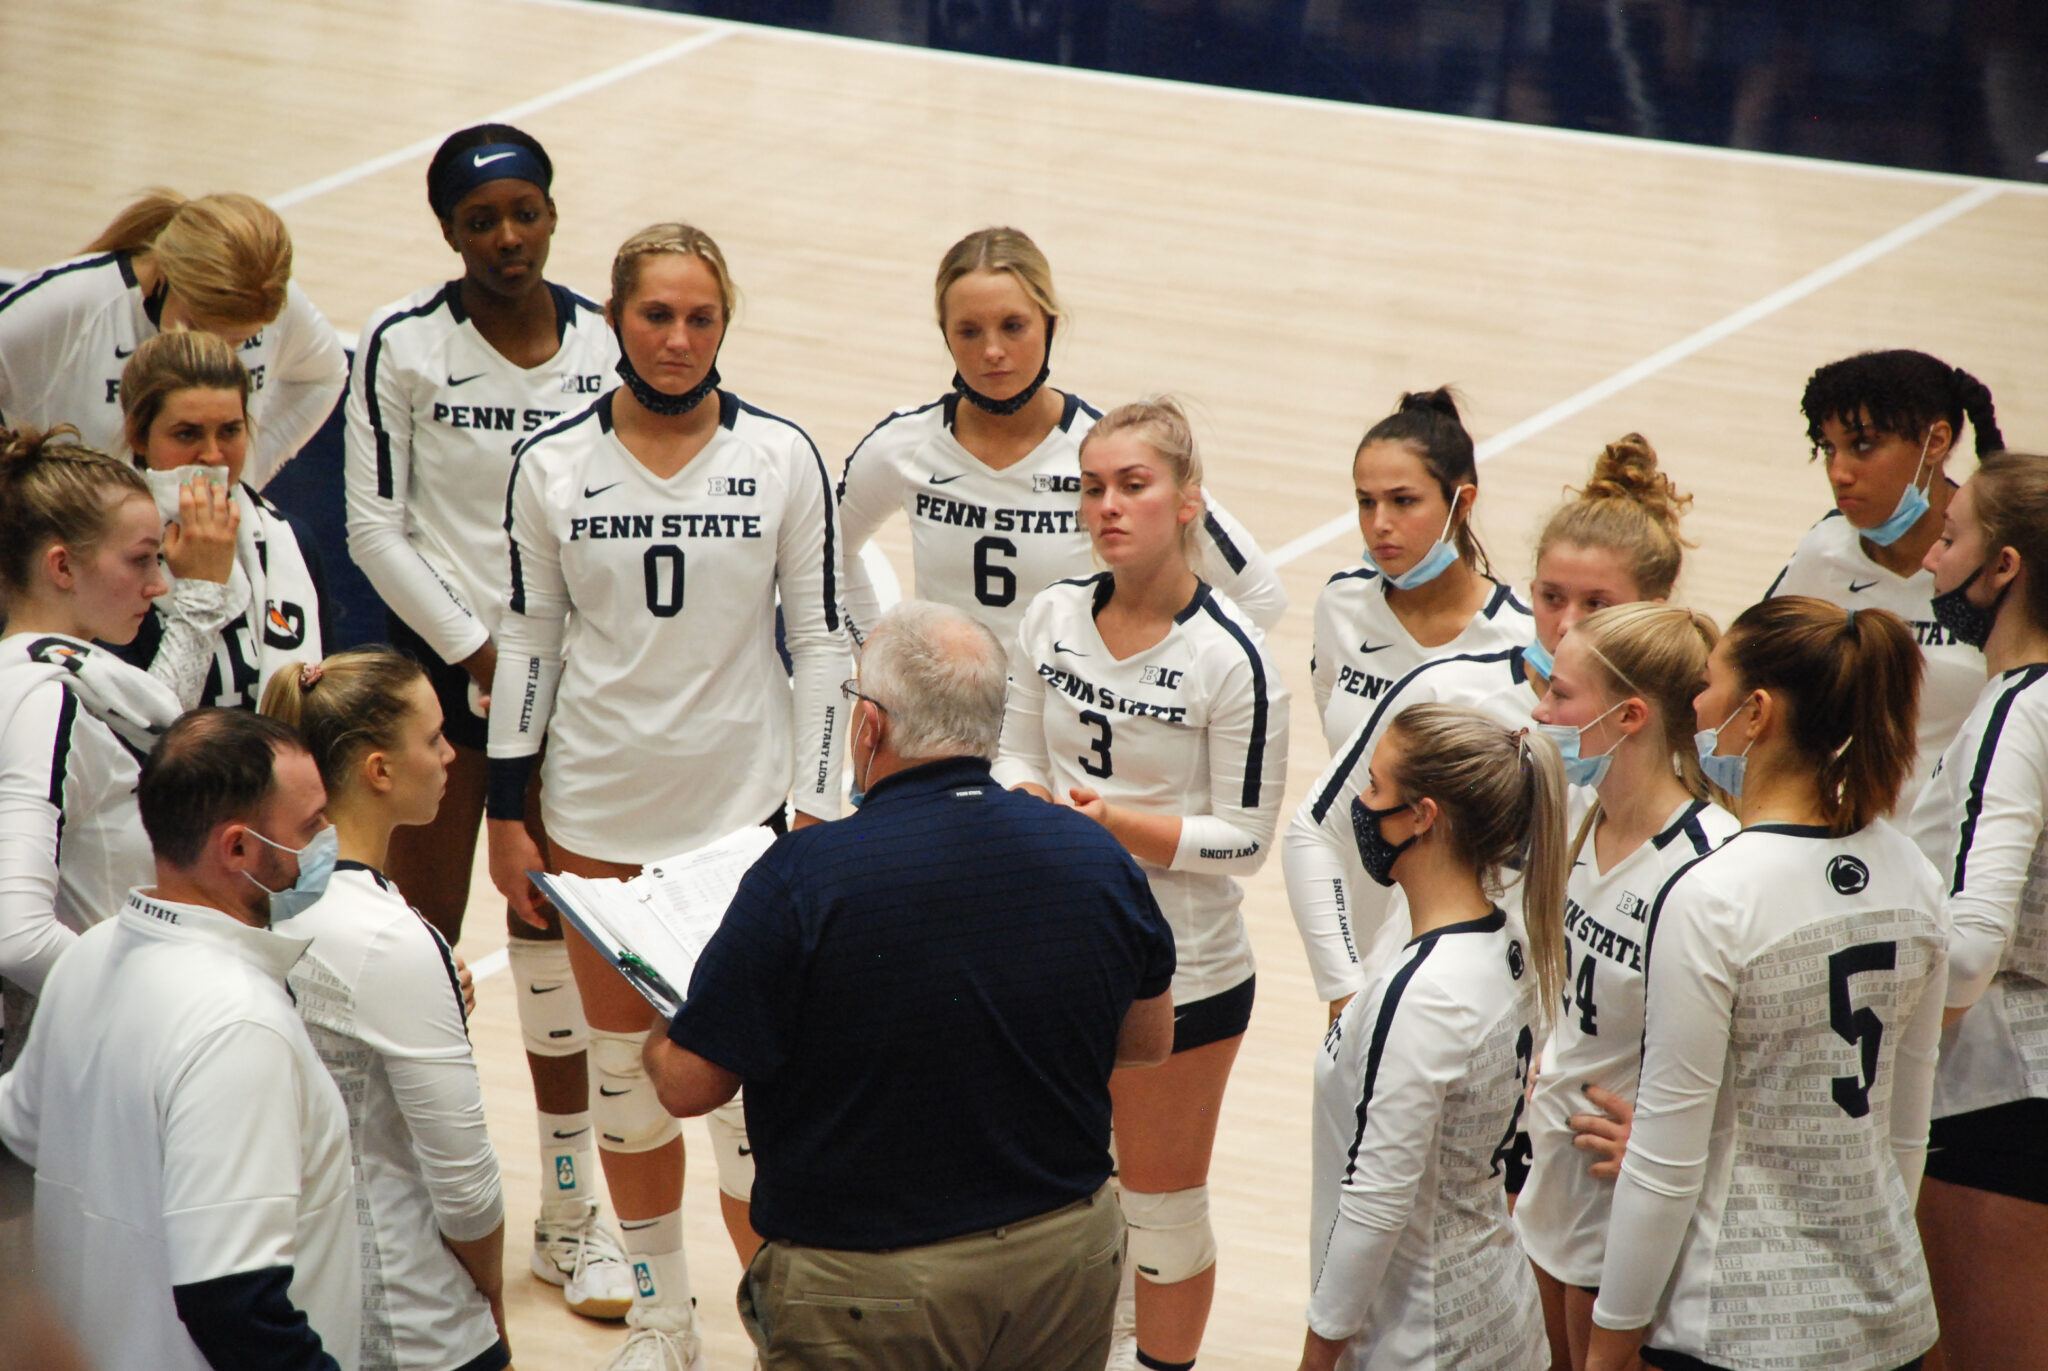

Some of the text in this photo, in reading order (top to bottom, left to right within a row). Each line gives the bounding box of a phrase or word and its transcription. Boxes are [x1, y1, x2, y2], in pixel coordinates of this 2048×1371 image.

[433, 402, 515, 431] PENN
[916, 493, 1081, 534] PENN STAT
[570, 515, 762, 541] PENN STATE
[644, 544, 685, 618] 0
[973, 535, 1017, 608] 6
[1038, 663, 1187, 723] PENN STATE
[519, 682, 537, 733] NITTANY
[816, 706, 835, 794] NITTANY LIONS
[1078, 709, 1113, 779] 3
[1200, 848, 1233, 859] LIONS
[144, 903, 178, 924] STATE
[1333, 878, 1358, 963] LIONS NITTANY
[1577, 915, 1642, 973] STATE
[1759, 957, 1818, 980] WE ARE
[1828, 941, 1897, 1119] 5
[1832, 1133, 1861, 1144] ARE
[1748, 1184, 1775, 1194] ARE
[1832, 1174, 1861, 1185] ARE
[1752, 1227, 1782, 1238] ARE
[1439, 1252, 1465, 1269] ARE
[1757, 1269, 1787, 1281] ARE
[1452, 1290, 1475, 1305] ARE
[1772, 1282, 1797, 1296] WE
[1802, 1280, 1830, 1294] ARE
[1761, 1313, 1791, 1324] ARE
[1777, 1324, 1835, 1339] WE ARE
[1765, 1357, 1794, 1368] ARE
